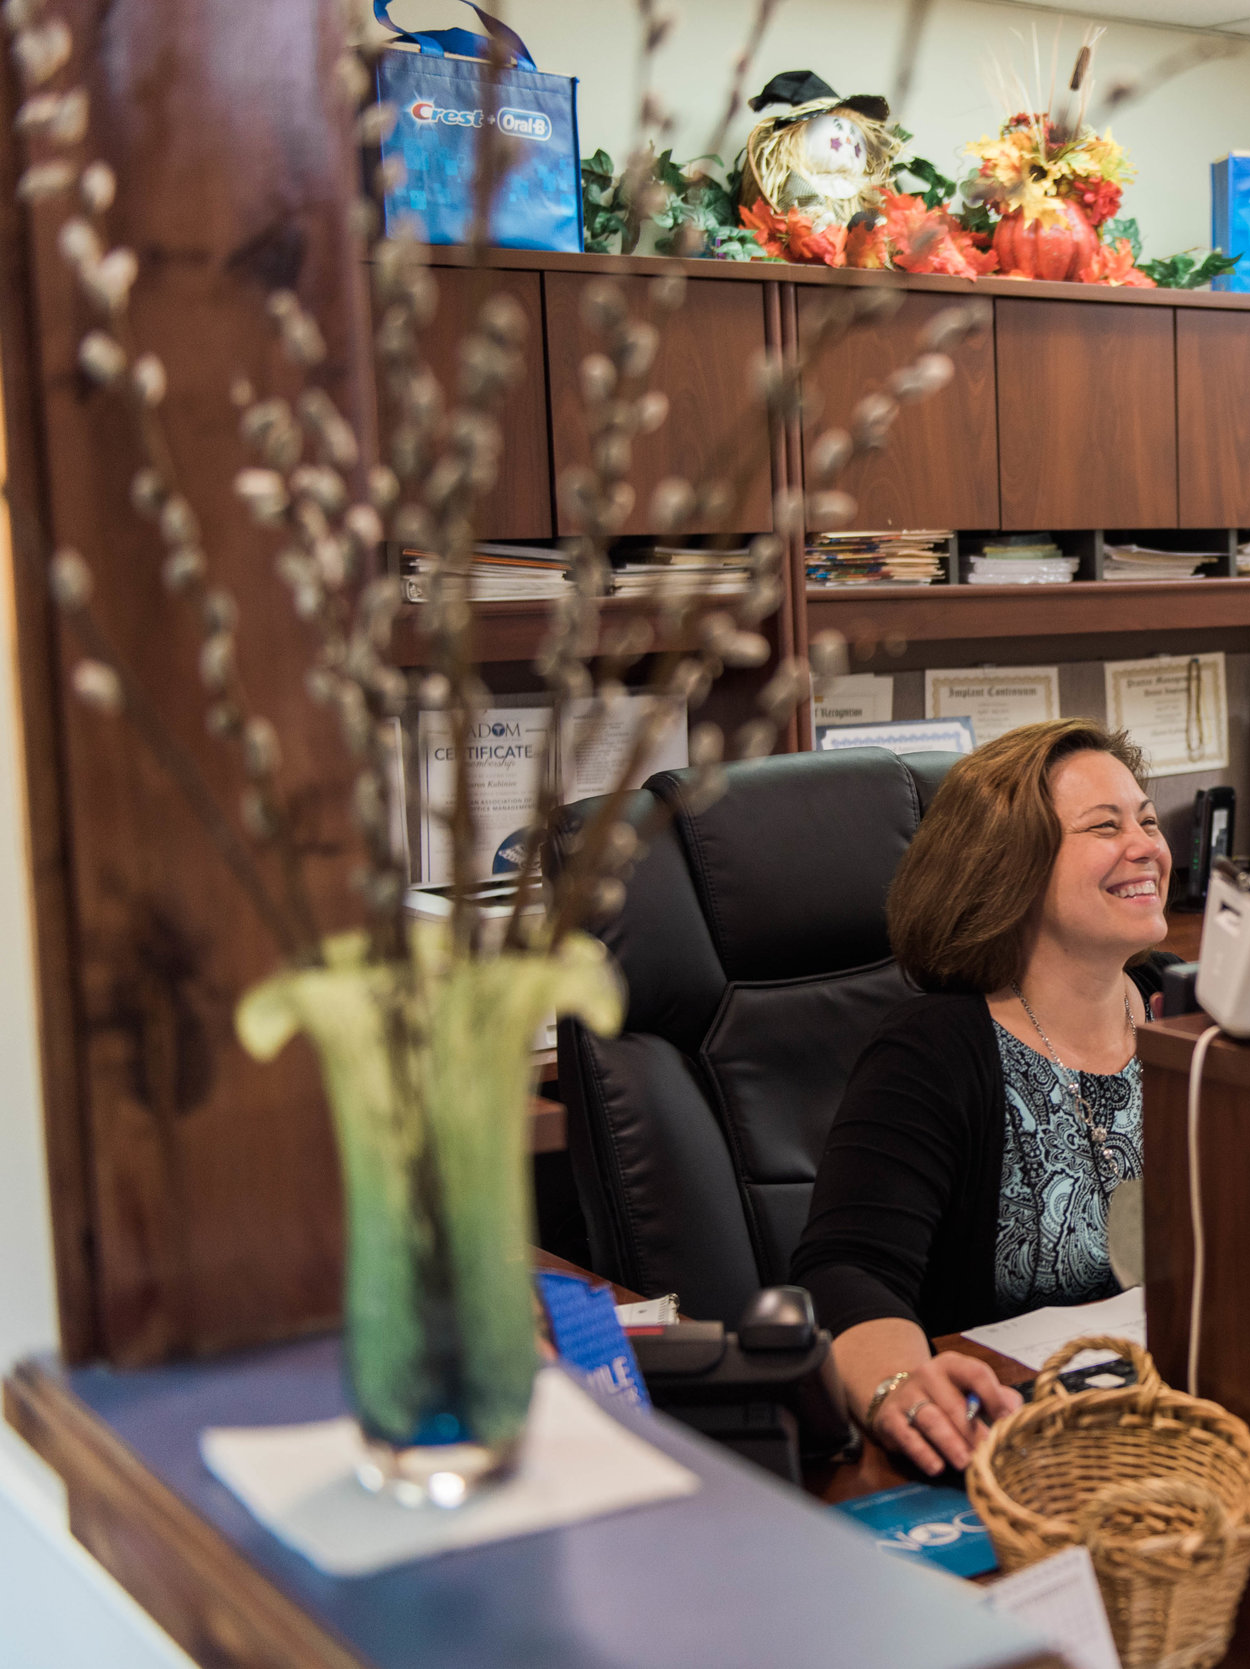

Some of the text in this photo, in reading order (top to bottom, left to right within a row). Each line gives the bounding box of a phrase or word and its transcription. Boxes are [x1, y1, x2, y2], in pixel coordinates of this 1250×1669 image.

[411, 102, 484, 128] Crest
[502, 113, 547, 136] Oral-B
[434, 745, 533, 761] CETIFICATE
